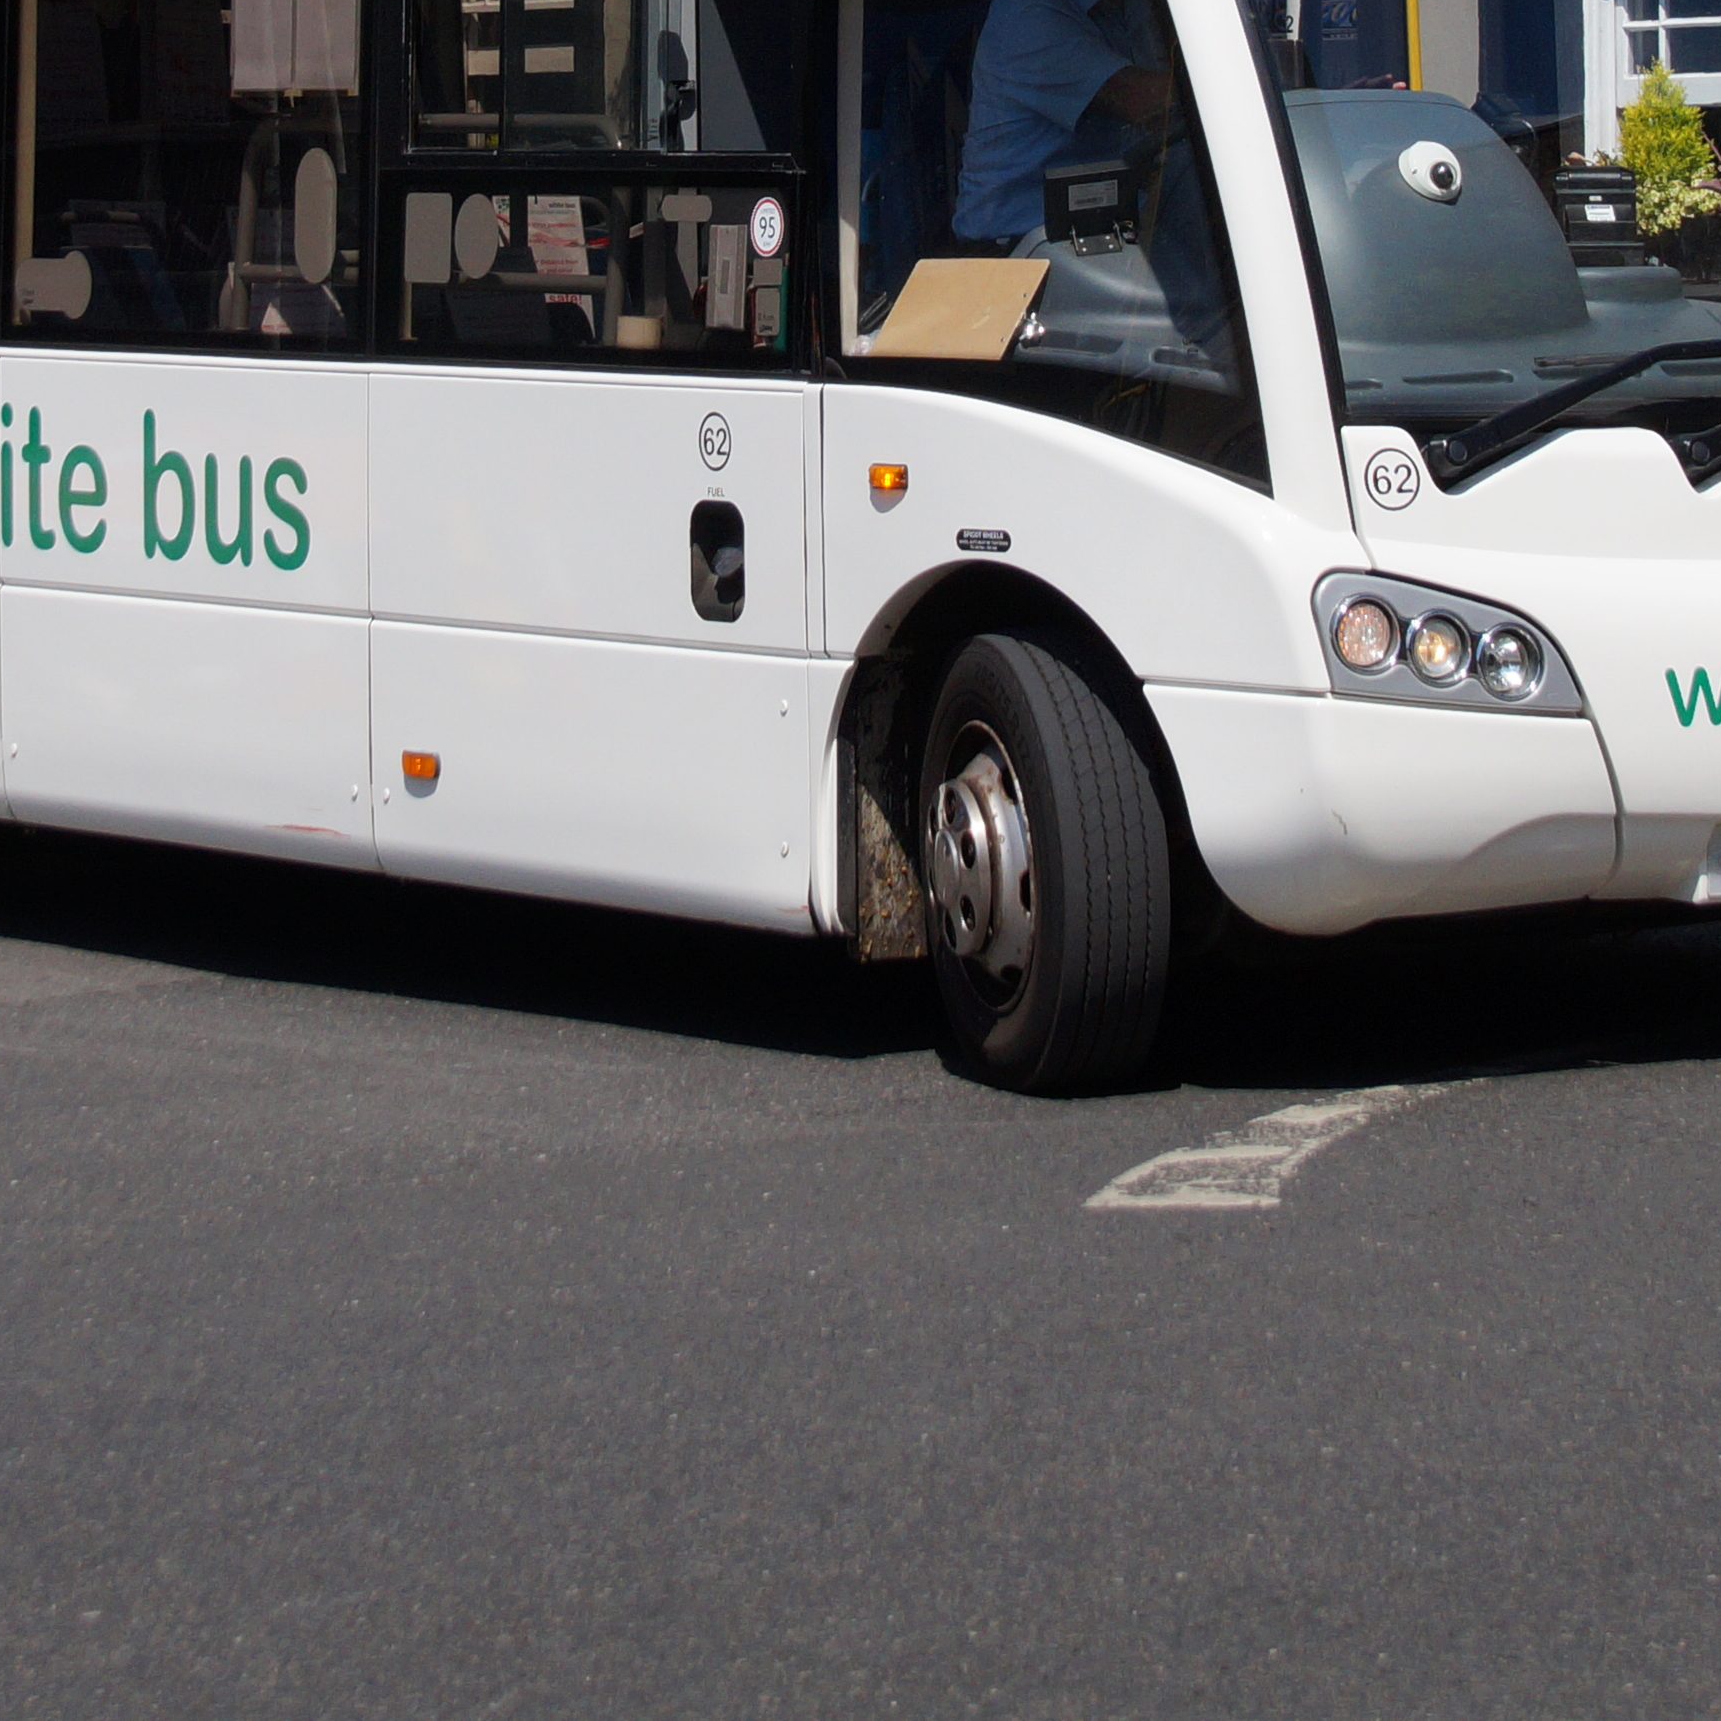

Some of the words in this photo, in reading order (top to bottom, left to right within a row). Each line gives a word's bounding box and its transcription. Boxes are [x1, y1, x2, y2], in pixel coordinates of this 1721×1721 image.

[759, 216, 776, 239] 95
[703, 427, 728, 456] 62
[143, 407, 312, 571] bus
[707, 486, 725, 497] FUEL
[1372, 463, 1414, 495] 62
